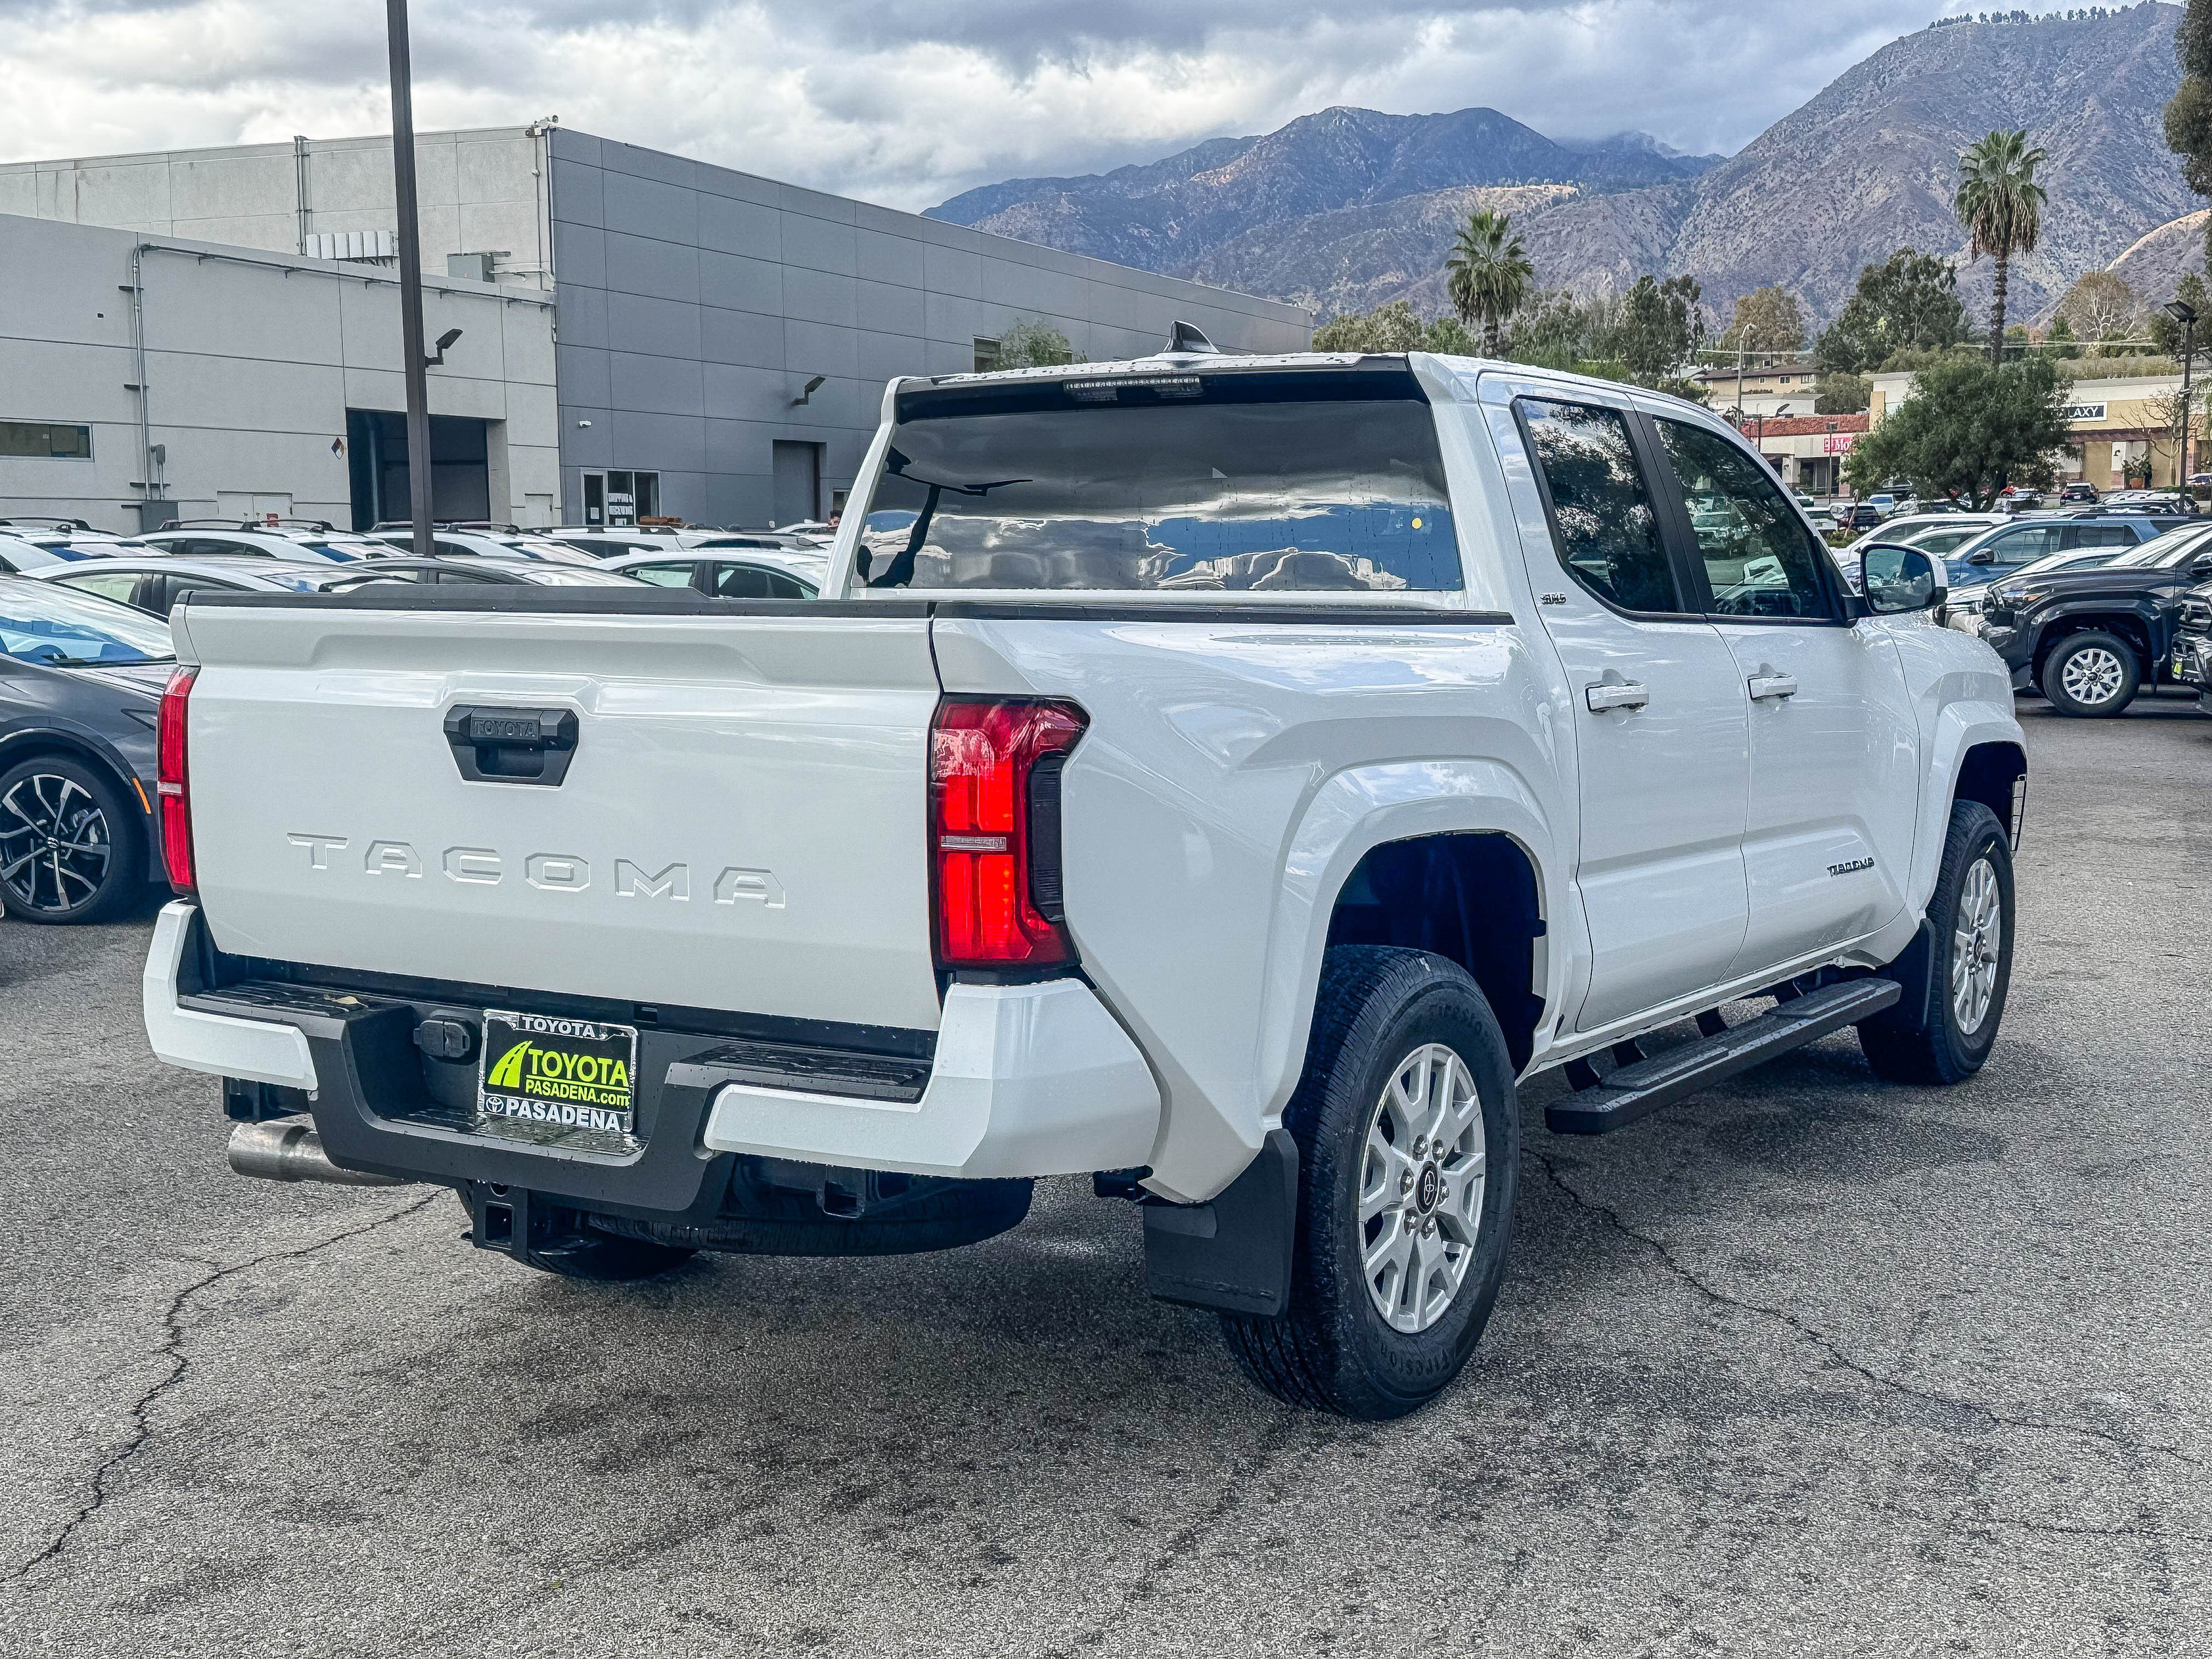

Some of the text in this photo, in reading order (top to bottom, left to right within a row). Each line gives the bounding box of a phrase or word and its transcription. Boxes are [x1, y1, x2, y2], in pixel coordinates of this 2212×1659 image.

[2068, 406, 2098, 418] LAXY
[1834, 438, 1853, 451] Mo
[473, 719, 535, 738] TOYOTA
[286, 831, 786, 910] TACOMA
[522, 1016, 596, 1038] TOYOTA
[528, 1048, 630, 1087] TOYOTA
[525, 1079, 629, 1107] PASADENA.com
[506, 1098, 620, 1132] PASADENA
